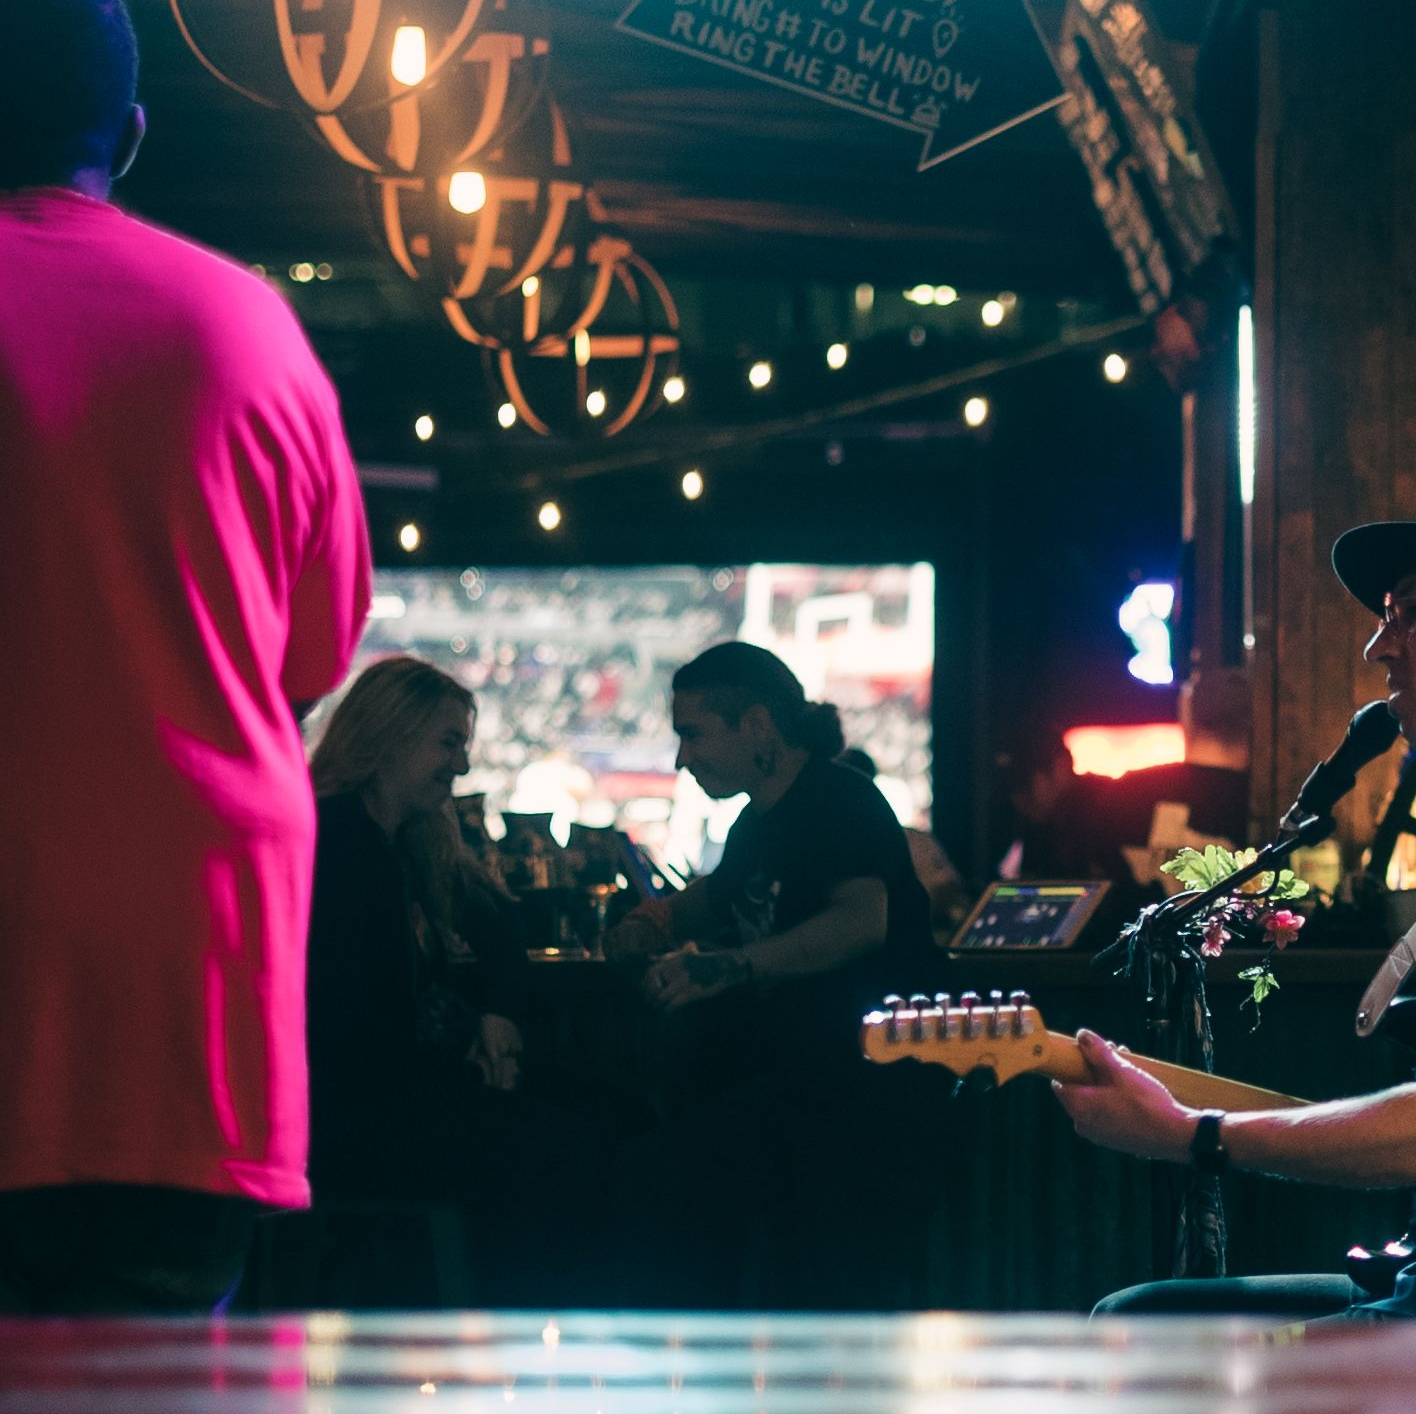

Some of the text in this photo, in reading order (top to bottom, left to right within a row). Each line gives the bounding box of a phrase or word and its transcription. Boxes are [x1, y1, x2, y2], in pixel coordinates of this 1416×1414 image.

[670, 11, 905, 115] RING THE BELL
[807, 18, 847, 55] TO
[856, 36, 982, 103] WINDOW
